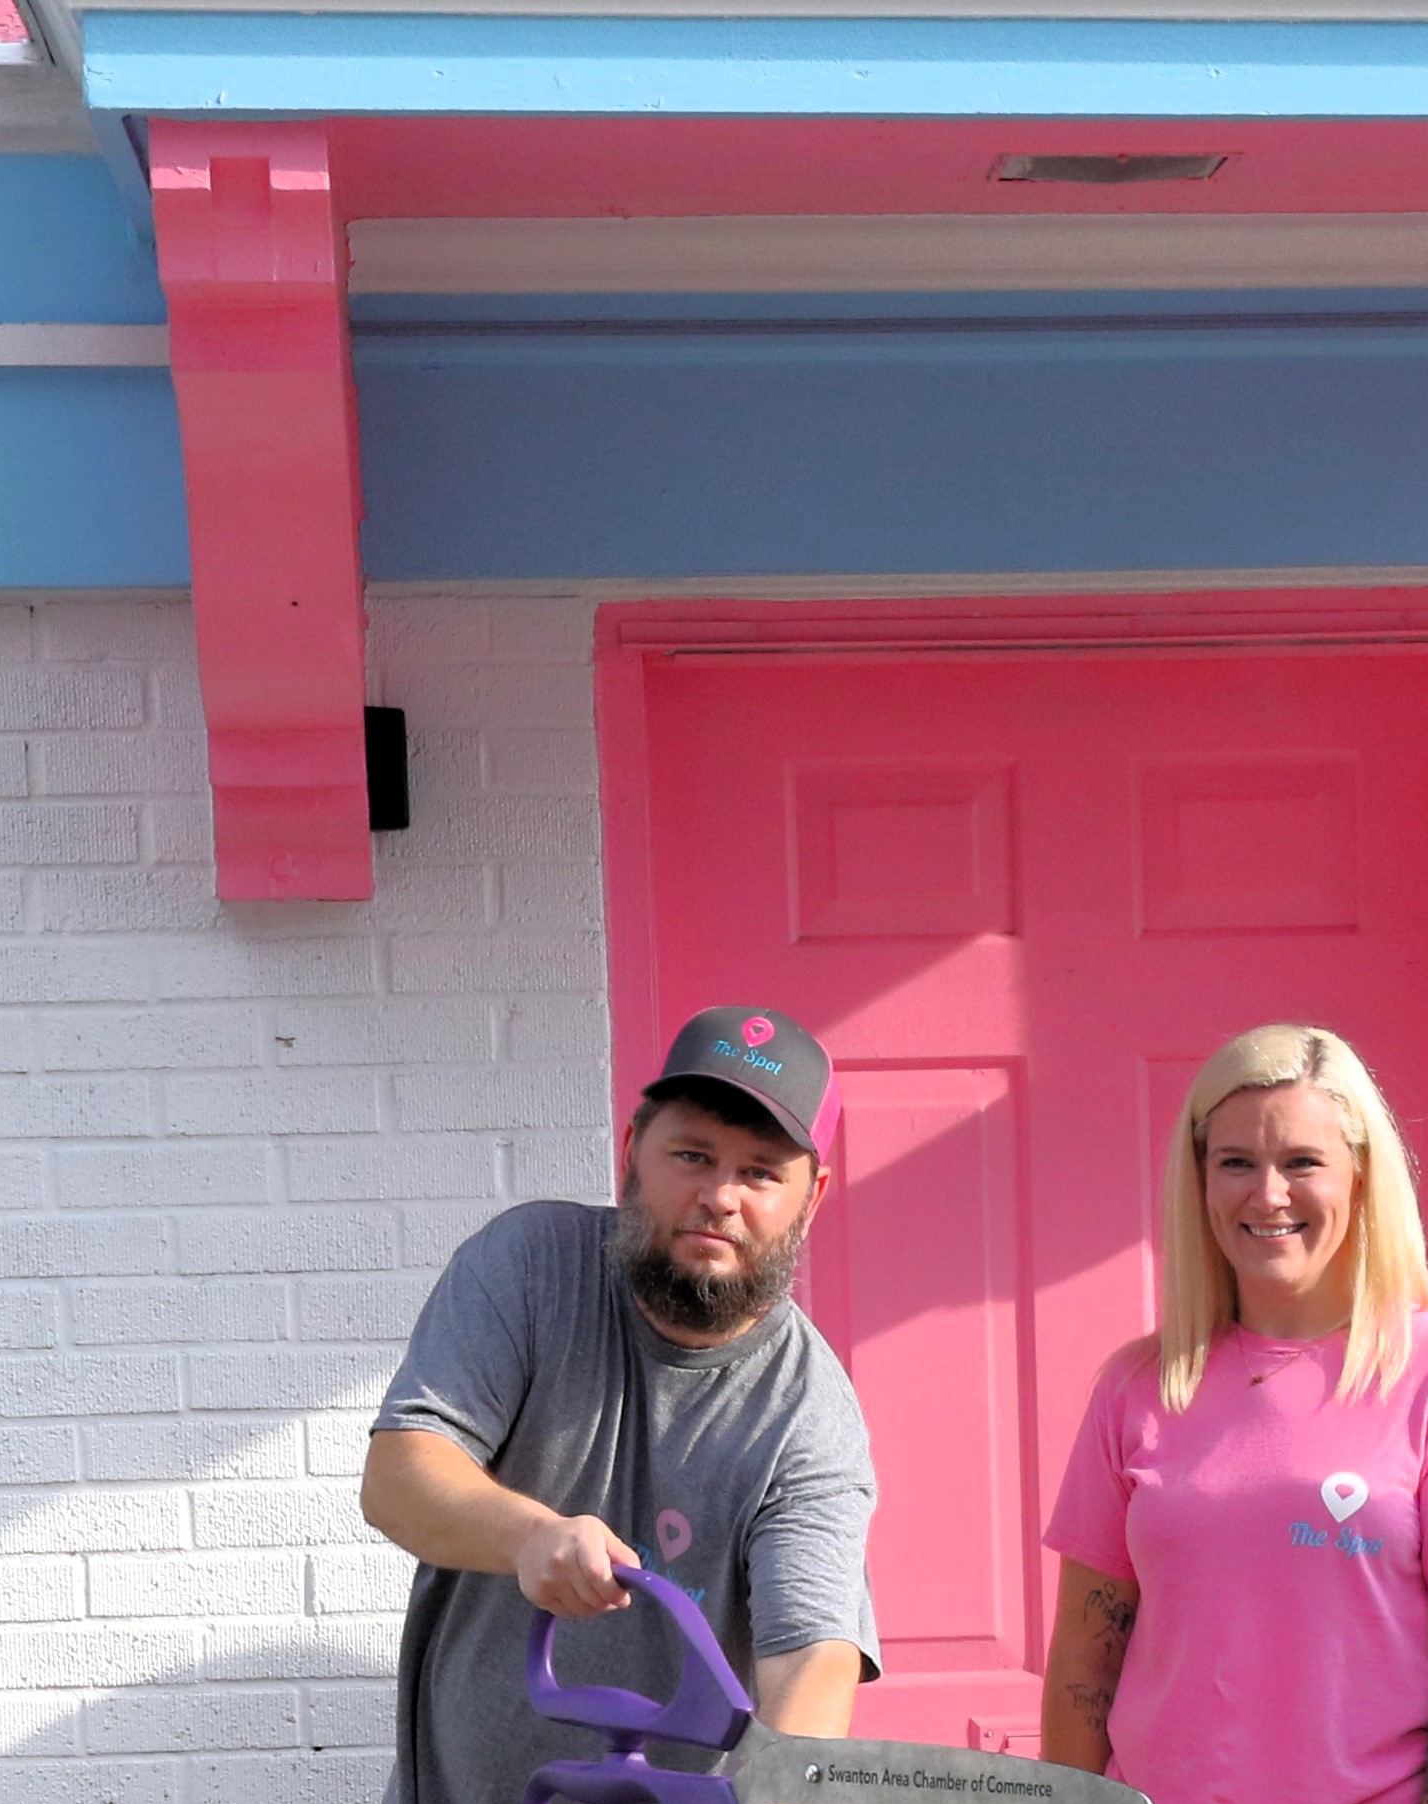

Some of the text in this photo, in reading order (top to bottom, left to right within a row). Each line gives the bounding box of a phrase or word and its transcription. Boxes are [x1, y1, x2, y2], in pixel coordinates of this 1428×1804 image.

[713, 1040, 783, 1076] The Spot
[1288, 1522, 1328, 1546] The
[828, 1764, 1053, 1798] Swanton Area Chamber of Commerce
